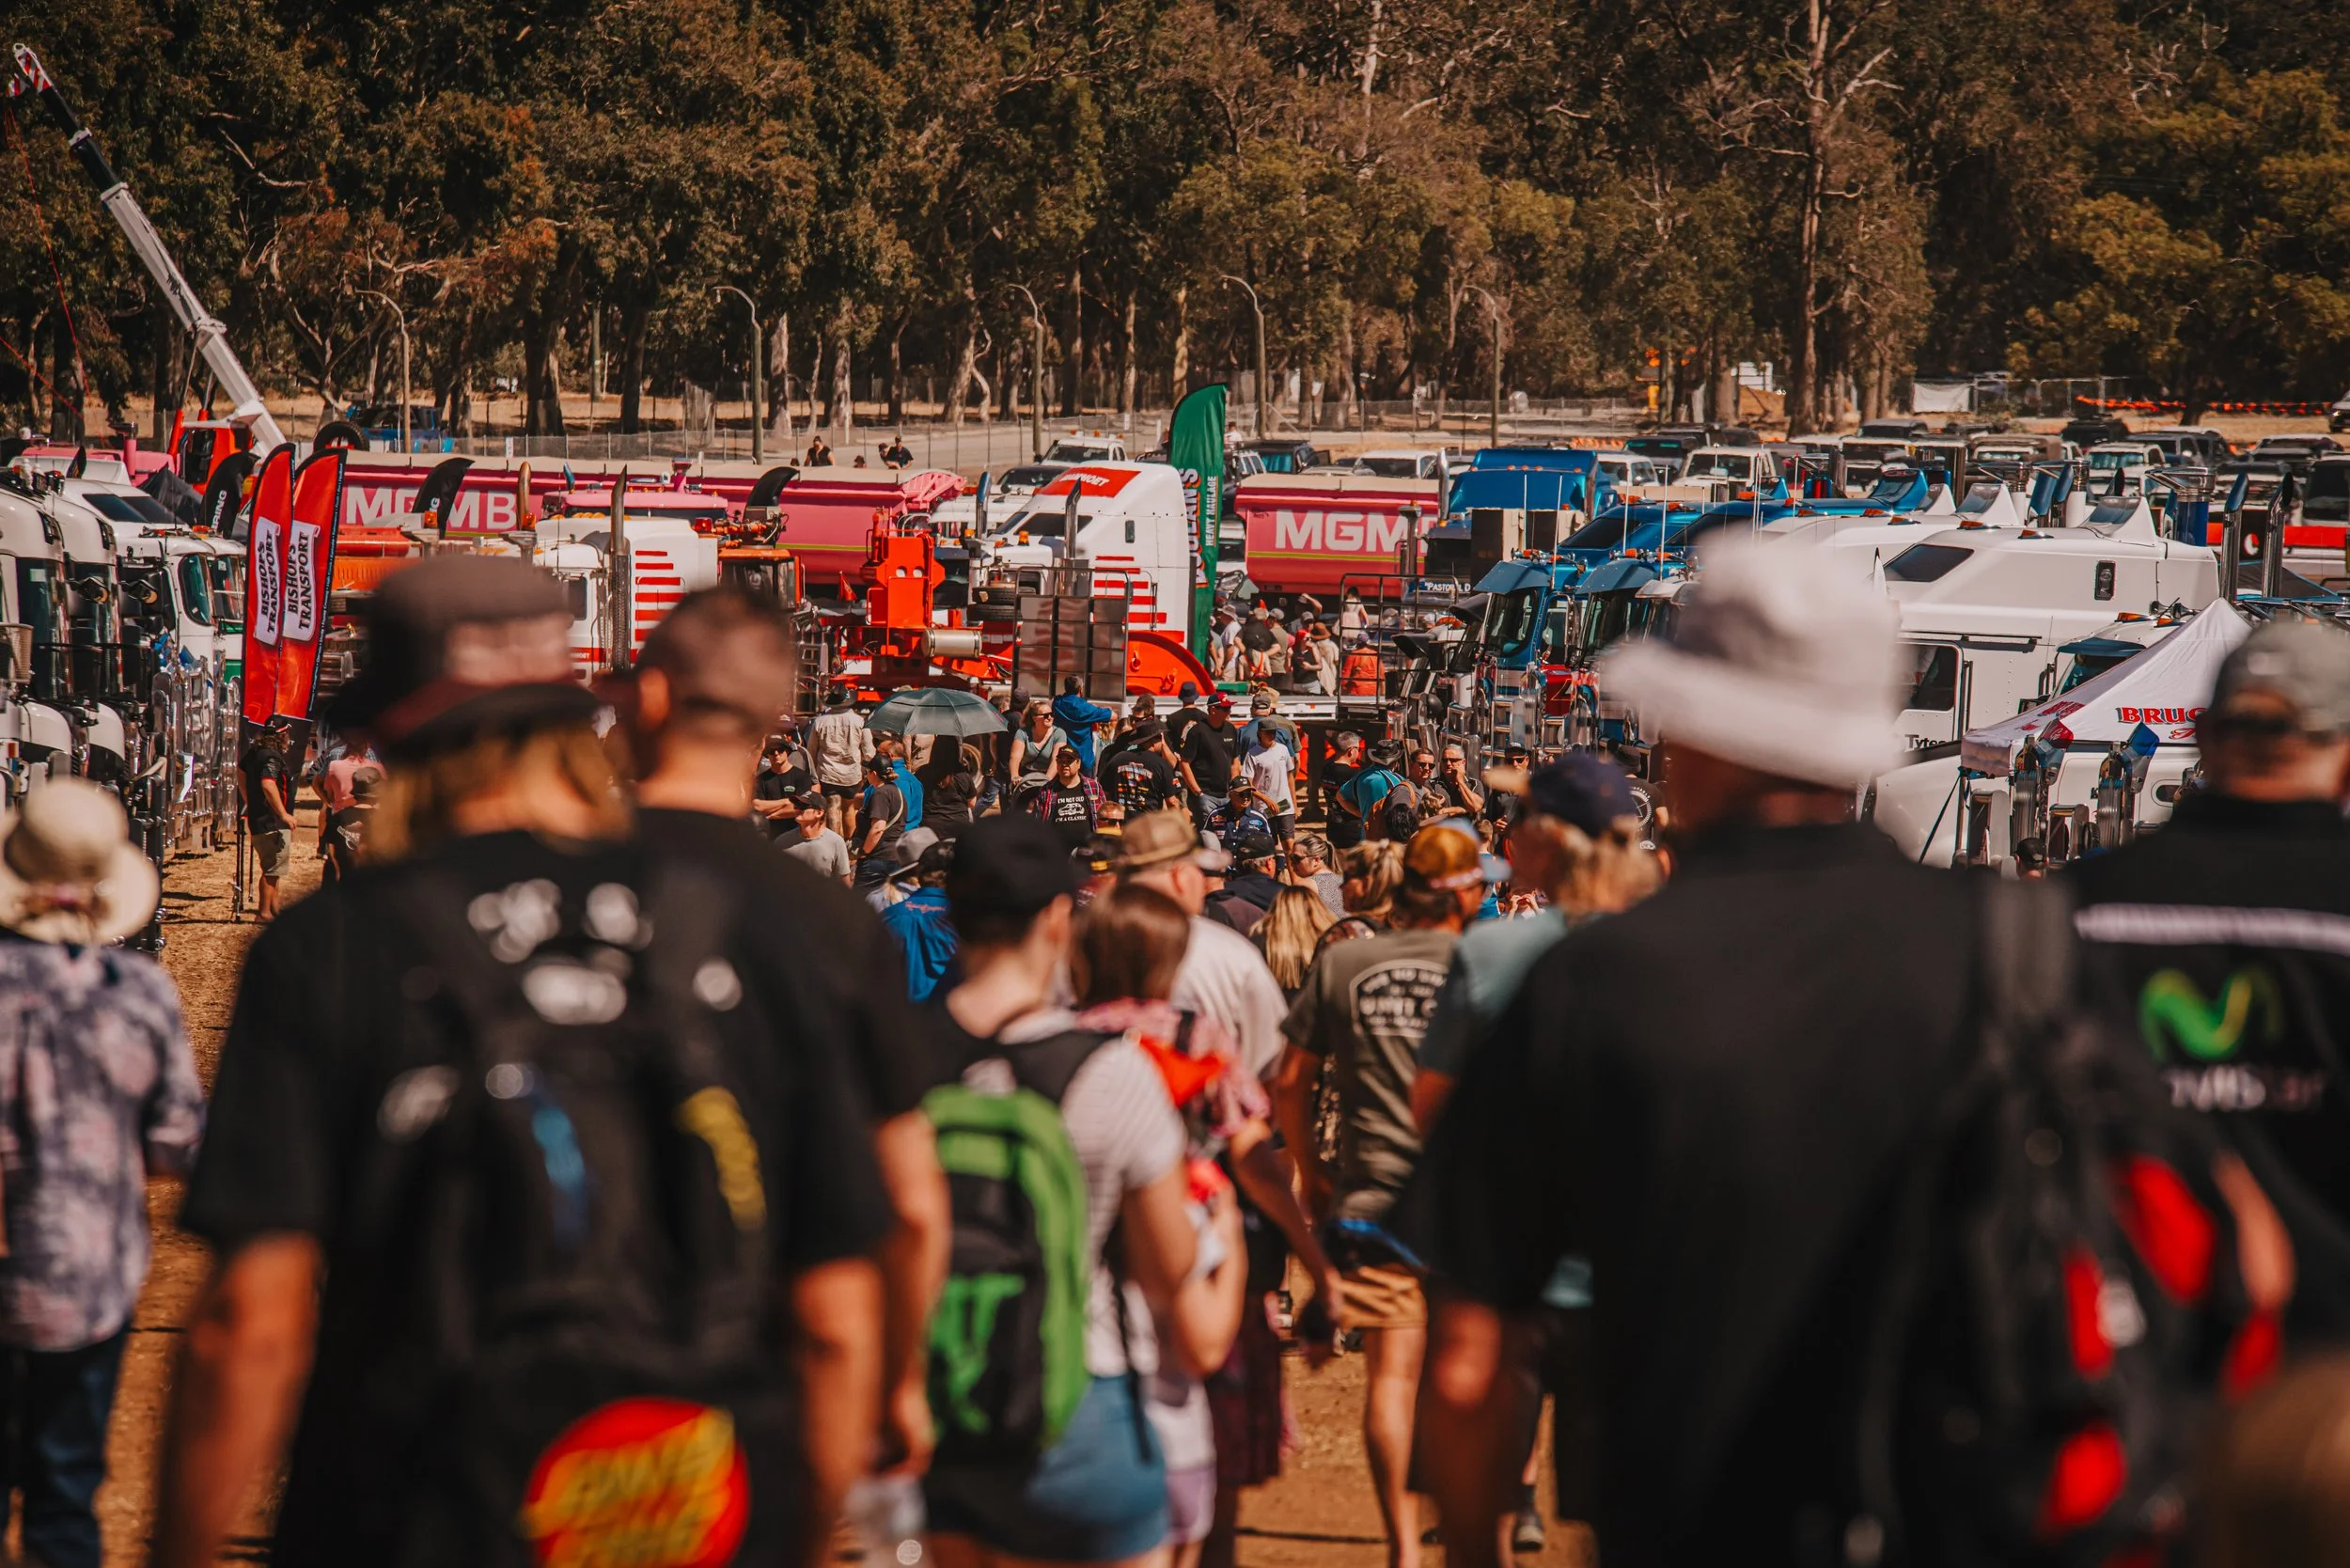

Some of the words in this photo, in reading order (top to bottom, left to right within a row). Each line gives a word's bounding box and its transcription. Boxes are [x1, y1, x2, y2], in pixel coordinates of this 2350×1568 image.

[1206, 476, 1216, 516] HAULAGE
[1205, 518, 1215, 546] HEAVY
[266, 529, 278, 634] TRANSPORT
[298, 531, 312, 630] TRANSPORT
